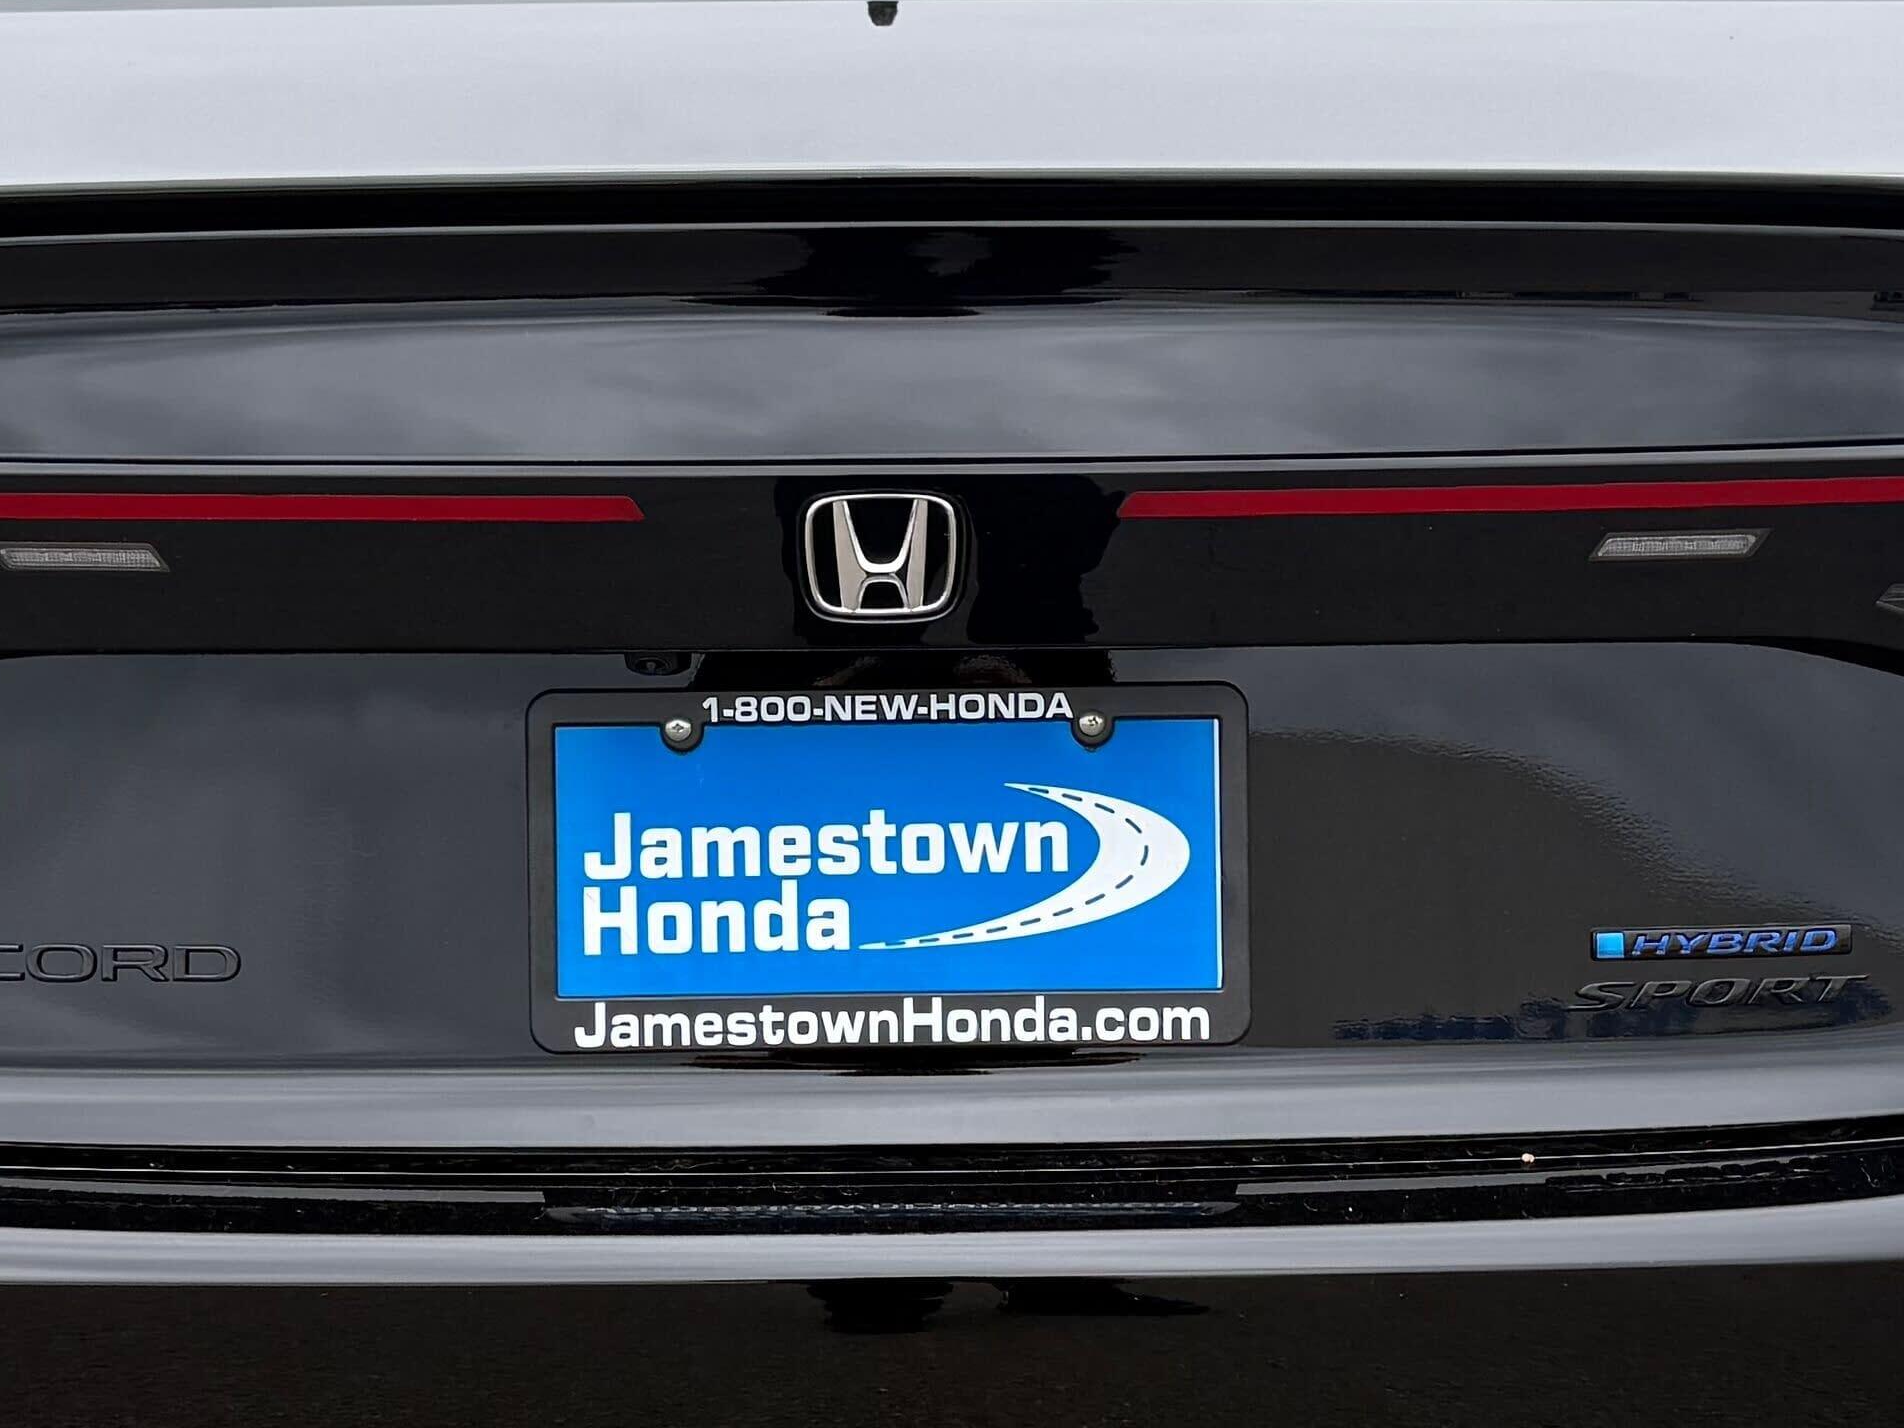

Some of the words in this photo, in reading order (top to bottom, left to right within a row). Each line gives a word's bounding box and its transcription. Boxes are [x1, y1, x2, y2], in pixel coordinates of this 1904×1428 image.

[702, 691, 1074, 724] 1-800-NEW-HONDA
[582, 809, 1070, 881] Jamestown
[582, 879, 851, 957] Honda
[1630, 927, 1839, 957] HYBRID
[1567, 973, 1871, 1013] SPORT
[573, 995, 1211, 1050] JamestownHonda.com
